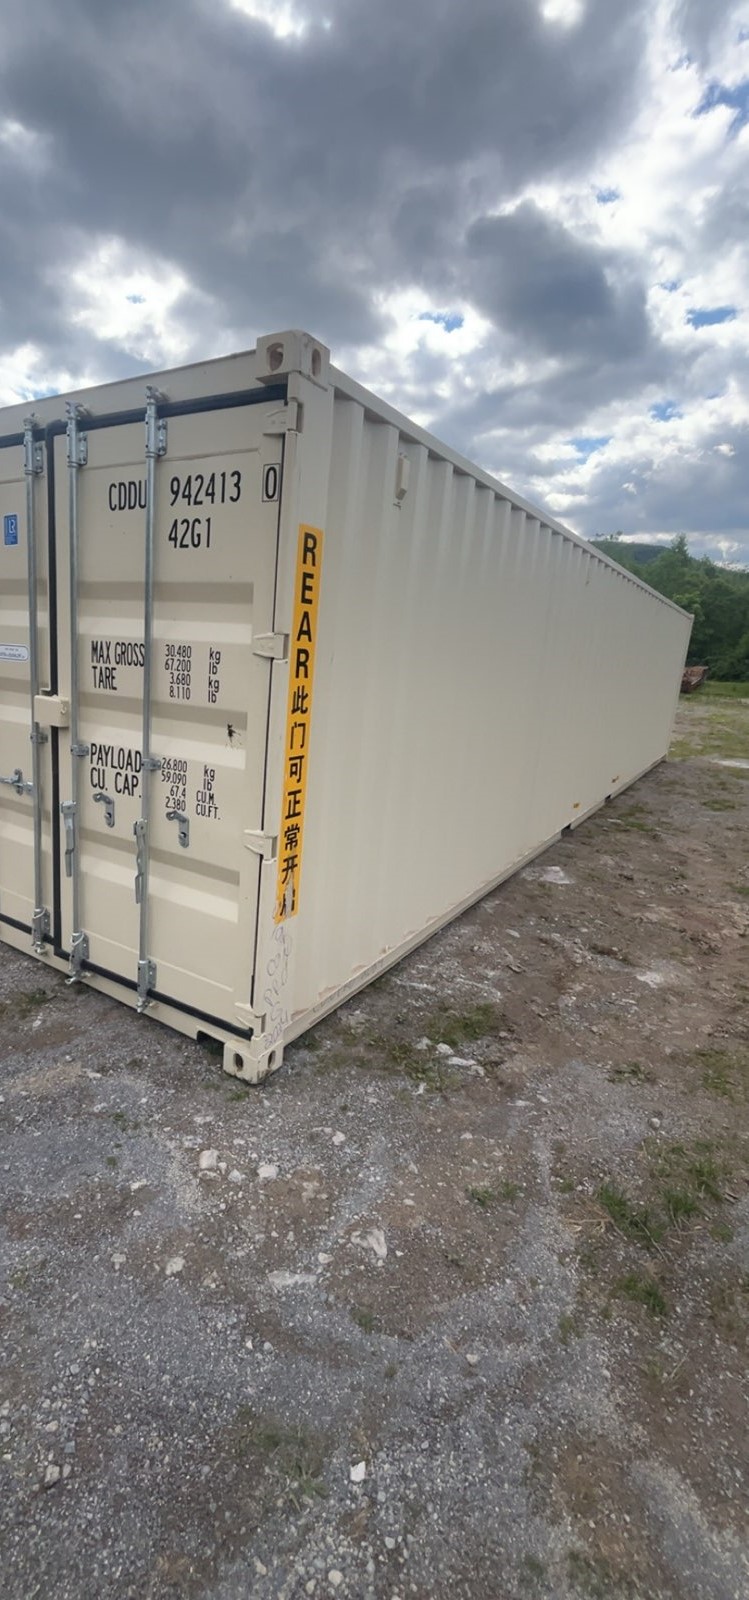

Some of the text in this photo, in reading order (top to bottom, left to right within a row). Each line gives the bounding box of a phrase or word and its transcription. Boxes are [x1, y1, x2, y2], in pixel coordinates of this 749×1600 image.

[109, 467, 277, 511] CDDU 942413 0
[168, 517, 212, 549] 42G1
[295, 532, 317, 678] REAR
[91, 640, 221, 667] MAX GROSS 30.480 kg
[164, 658, 218, 675] 67.200 lb
[92, 666, 220, 693] TARE 3.680 kg
[169, 686, 217, 703] 8.110 lb
[90, 743, 215, 781] PAYLOAD 26.800 kg
[90, 767, 108, 791] CU.
[115, 772, 141, 798] CAP.
[170, 785, 186, 798] 67.4
[161, 771, 212, 791] 59.090 lb
[165, 796, 221, 820] 2.380 CU.FT.
[279, 685, 309, 916] 此门可正常开
